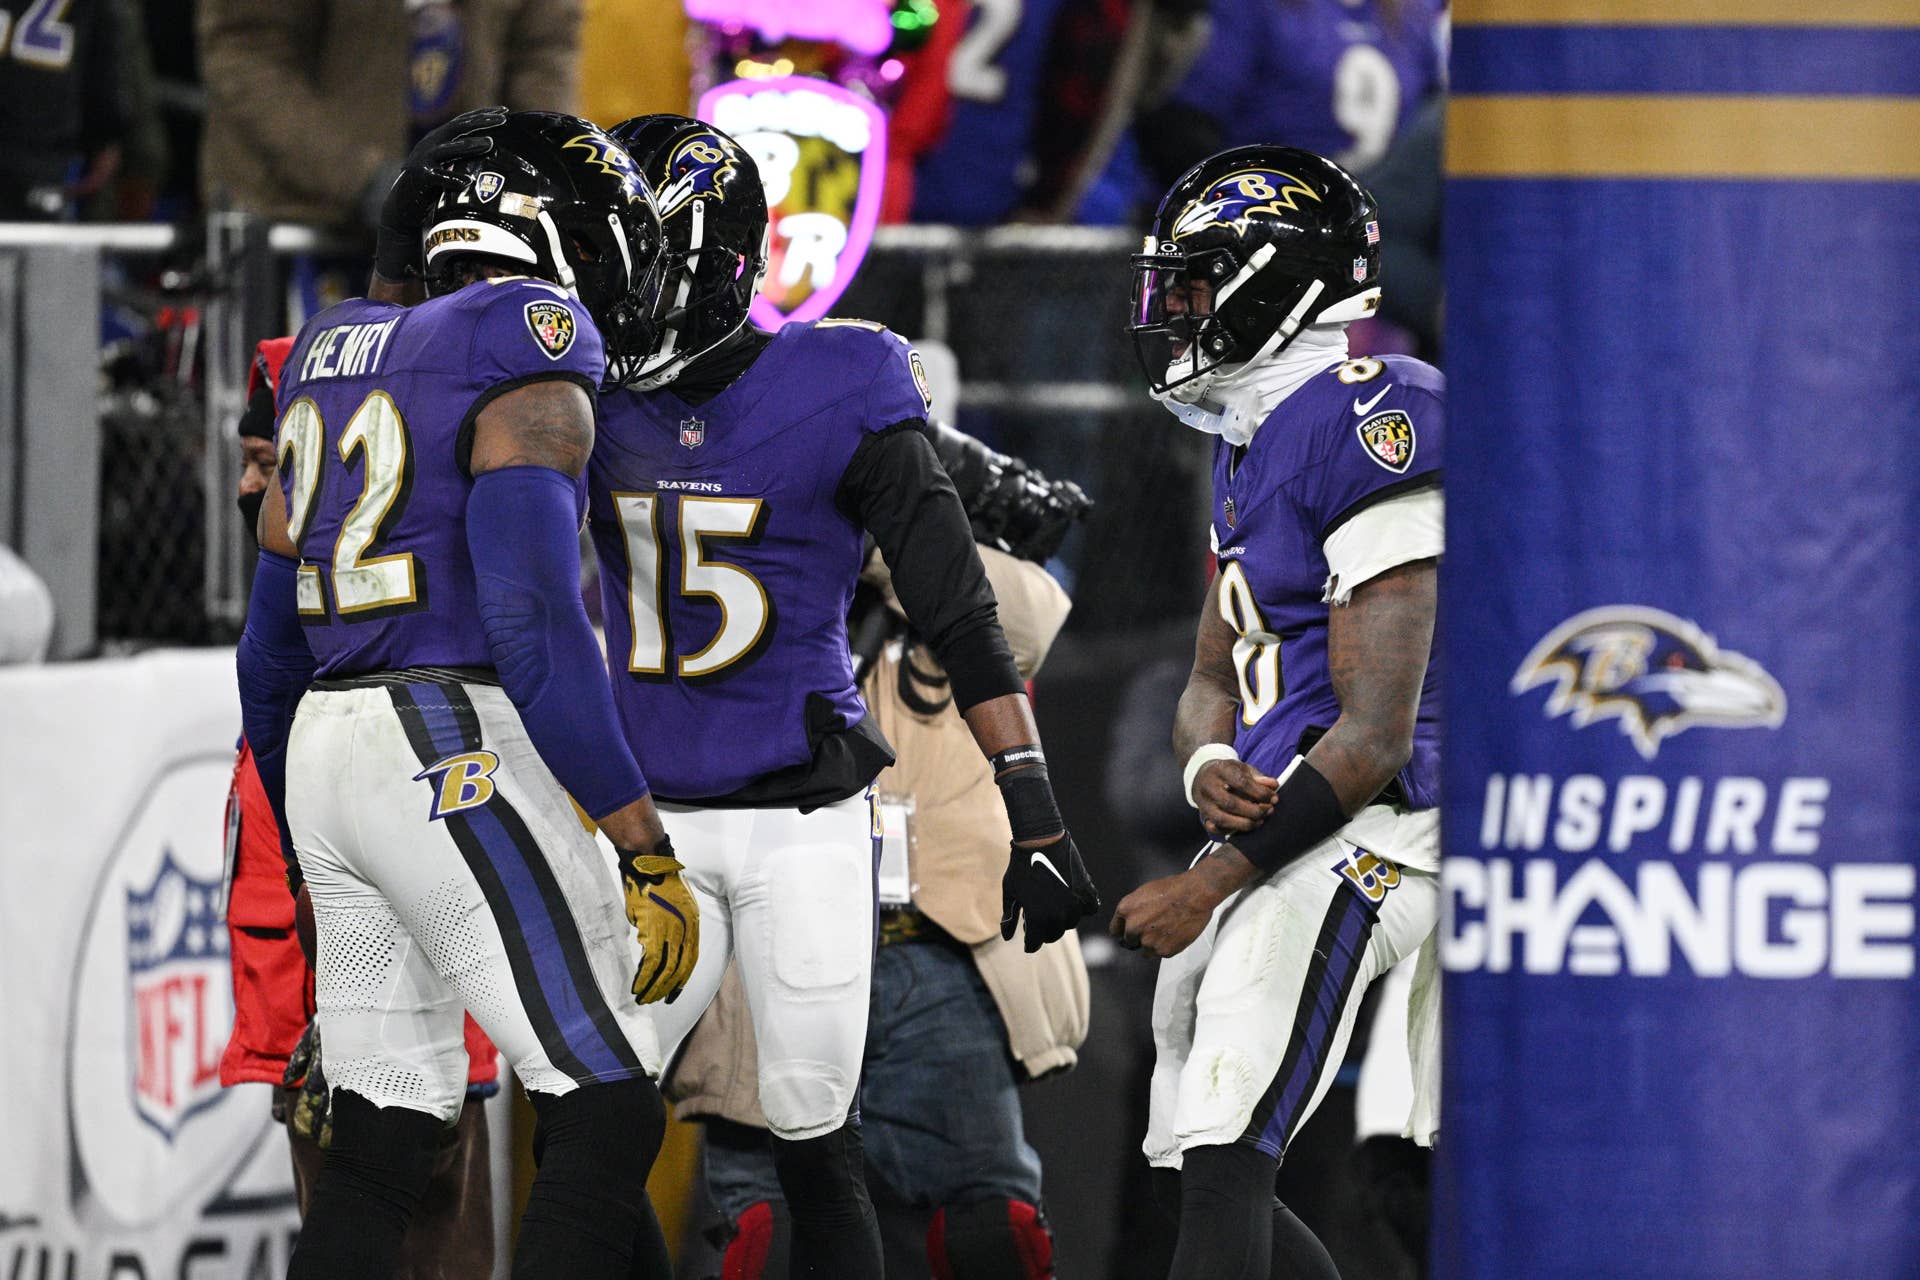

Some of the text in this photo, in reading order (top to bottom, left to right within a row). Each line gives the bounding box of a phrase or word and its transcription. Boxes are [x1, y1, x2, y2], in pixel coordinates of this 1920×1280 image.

[1331, 42, 1401, 174] 9
[301, 315, 400, 383] HENRY
[530, 304, 569, 317] RAVENS
[682, 431, 701, 444] NFL
[1362, 414, 1403, 434] RAVENS
[278, 388, 419, 616] 22
[656, 480, 723, 492] RAVENS
[611, 490, 768, 677] 15
[1217, 559, 1283, 727] 8
[412, 750, 500, 822] B
[1481, 773, 1832, 855] INSPIRE
[1438, 856, 1917, 979] CHANGE
[136, 976, 220, 1108] NFL
